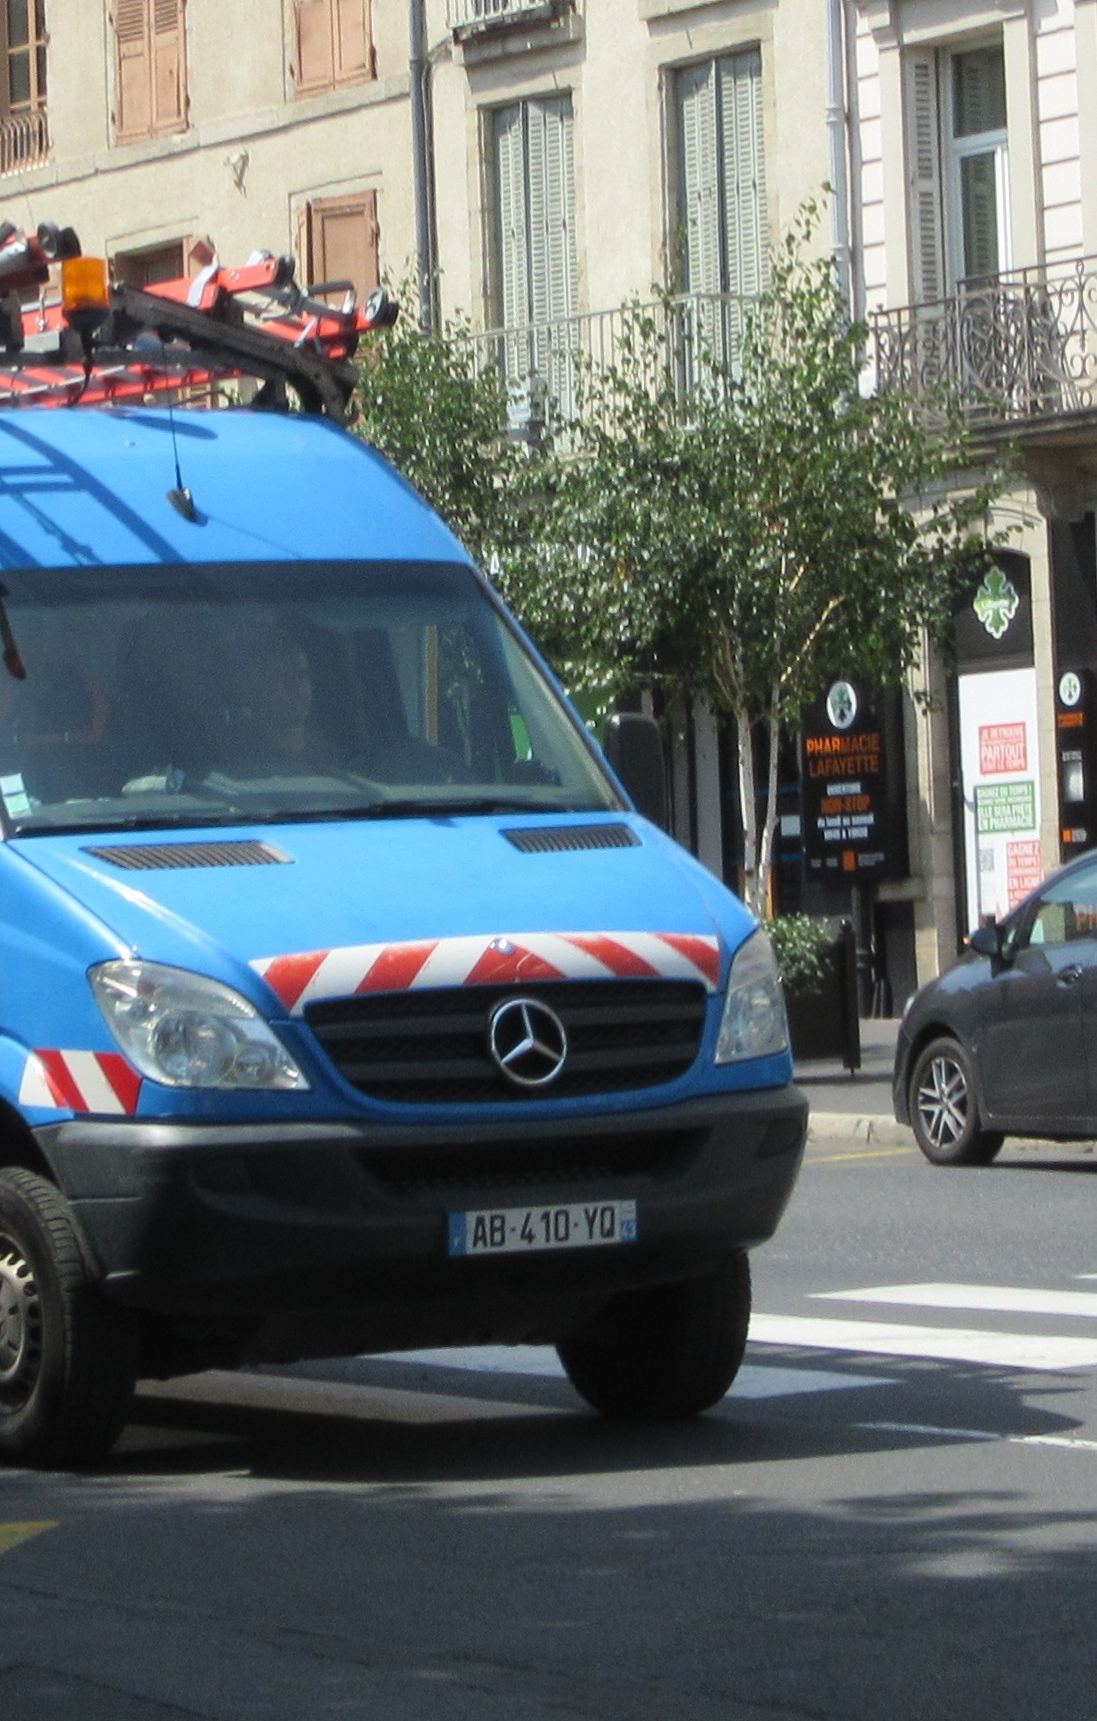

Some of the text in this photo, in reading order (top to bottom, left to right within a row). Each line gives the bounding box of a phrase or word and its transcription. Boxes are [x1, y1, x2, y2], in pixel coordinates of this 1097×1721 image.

[806, 733, 880, 755] PHARMACIE
[982, 742, 1025, 762] PARTOUT
[809, 754, 879, 777] LAFAYETTE
[472, 1206, 616, 1249] AB-410-YQ
